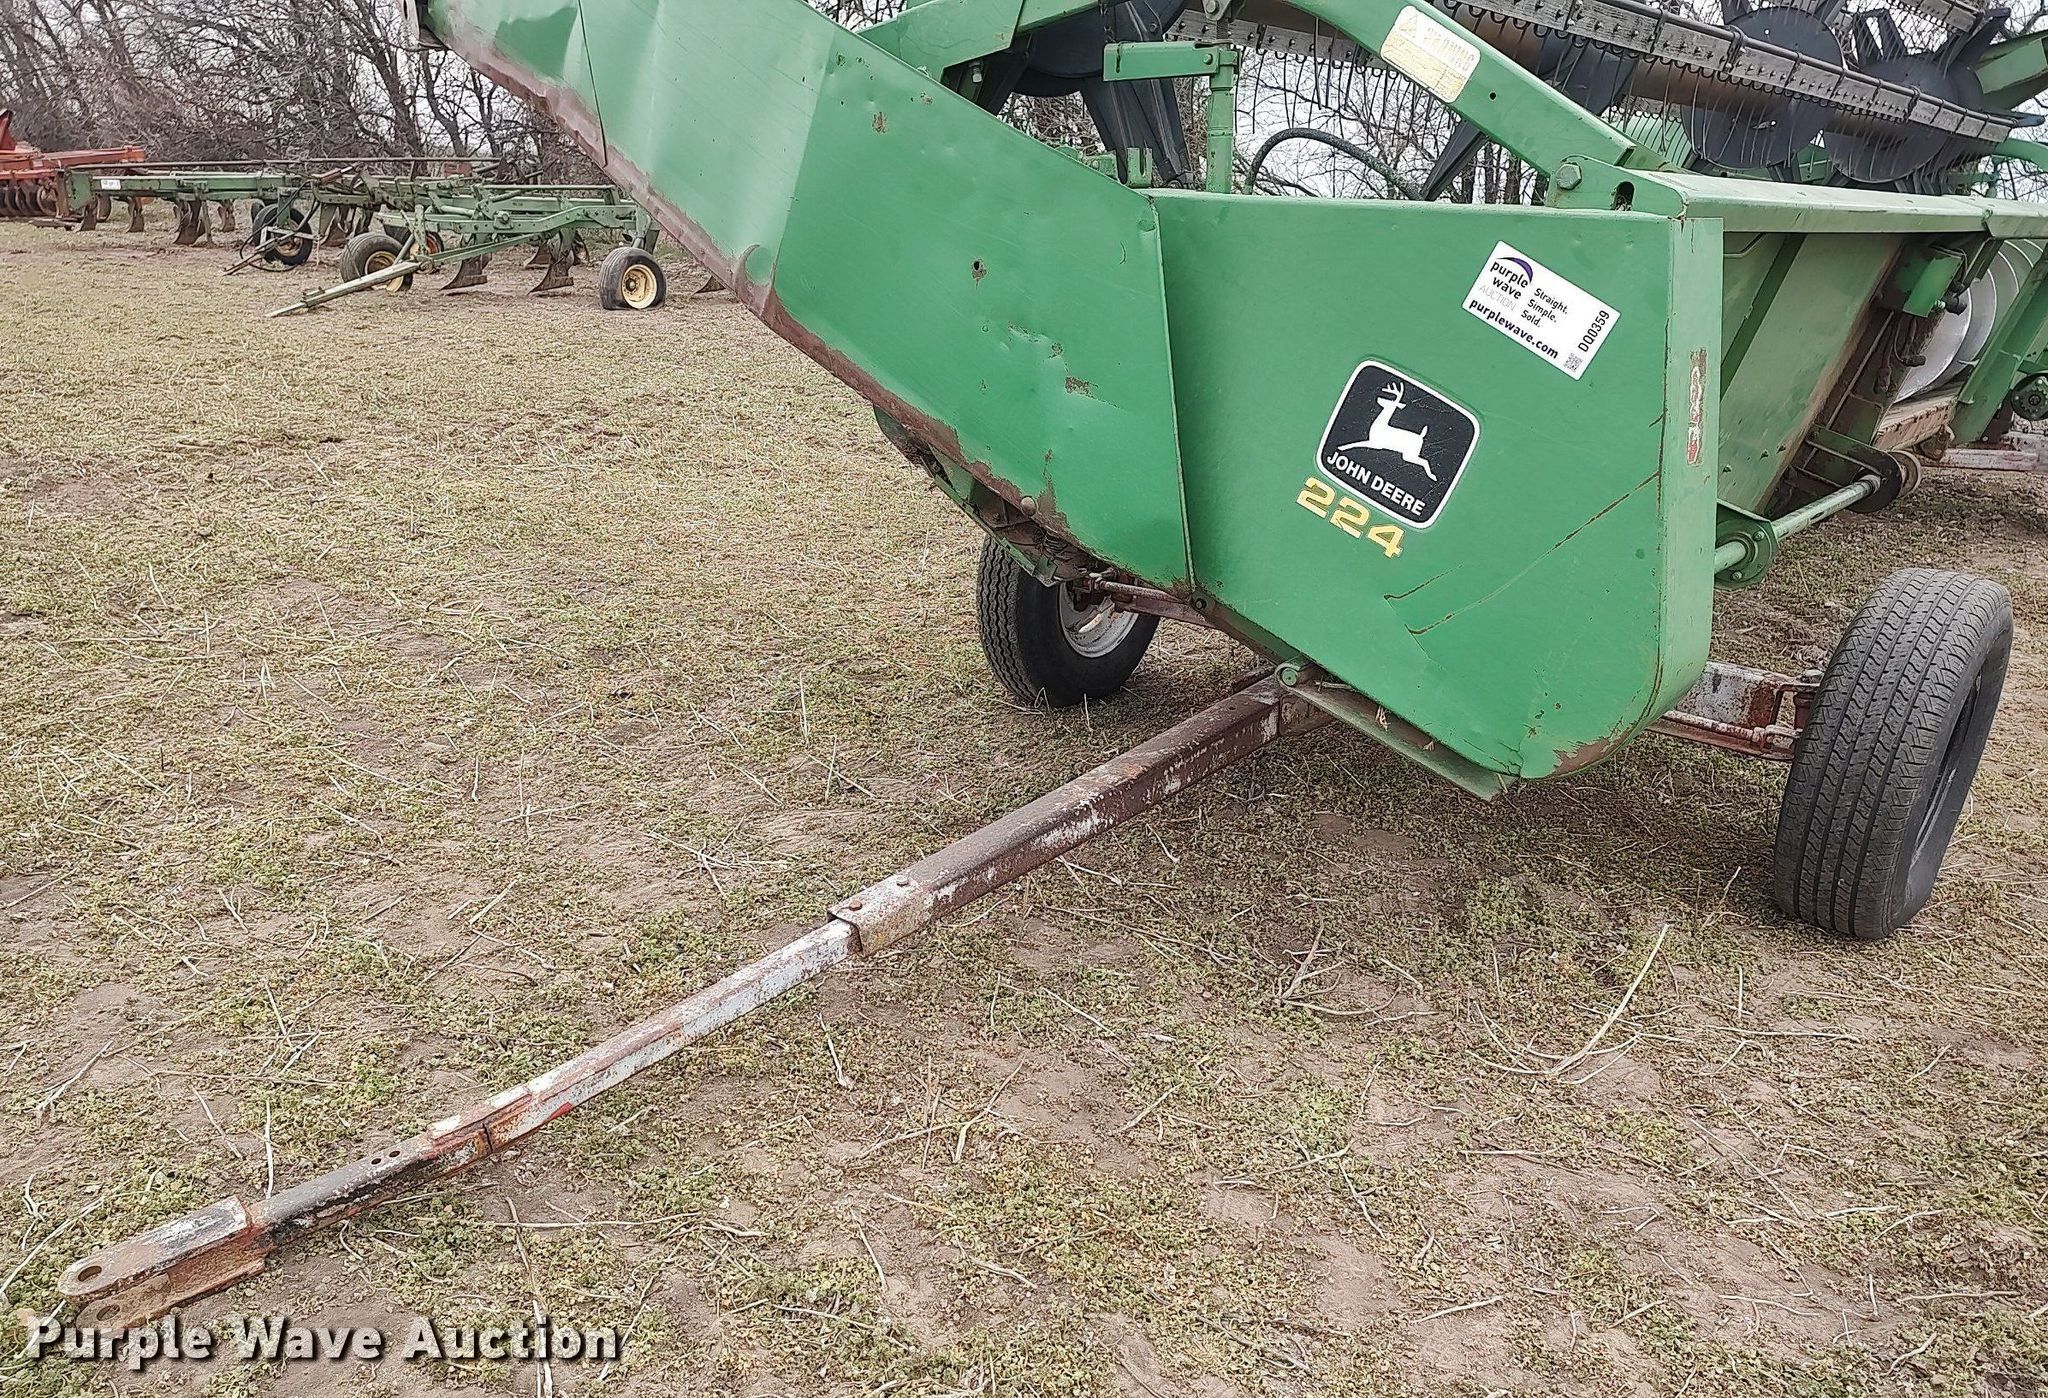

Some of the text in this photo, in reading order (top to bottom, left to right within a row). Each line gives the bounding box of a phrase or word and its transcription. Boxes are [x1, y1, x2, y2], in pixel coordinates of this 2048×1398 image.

[1490, 261, 1528, 288] purple
[1479, 284, 1516, 311] AUCTION
[1492, 277, 1522, 300] wave
[1534, 287, 1568, 314] Straight.
[1520, 309, 1540, 328] Sold.
[1527, 298, 1557, 323] Simple.
[1469, 299, 1558, 359] purplewave.com
[1326, 451, 1426, 517] JOHN DEERE
[1296, 477, 1405, 560] 224
